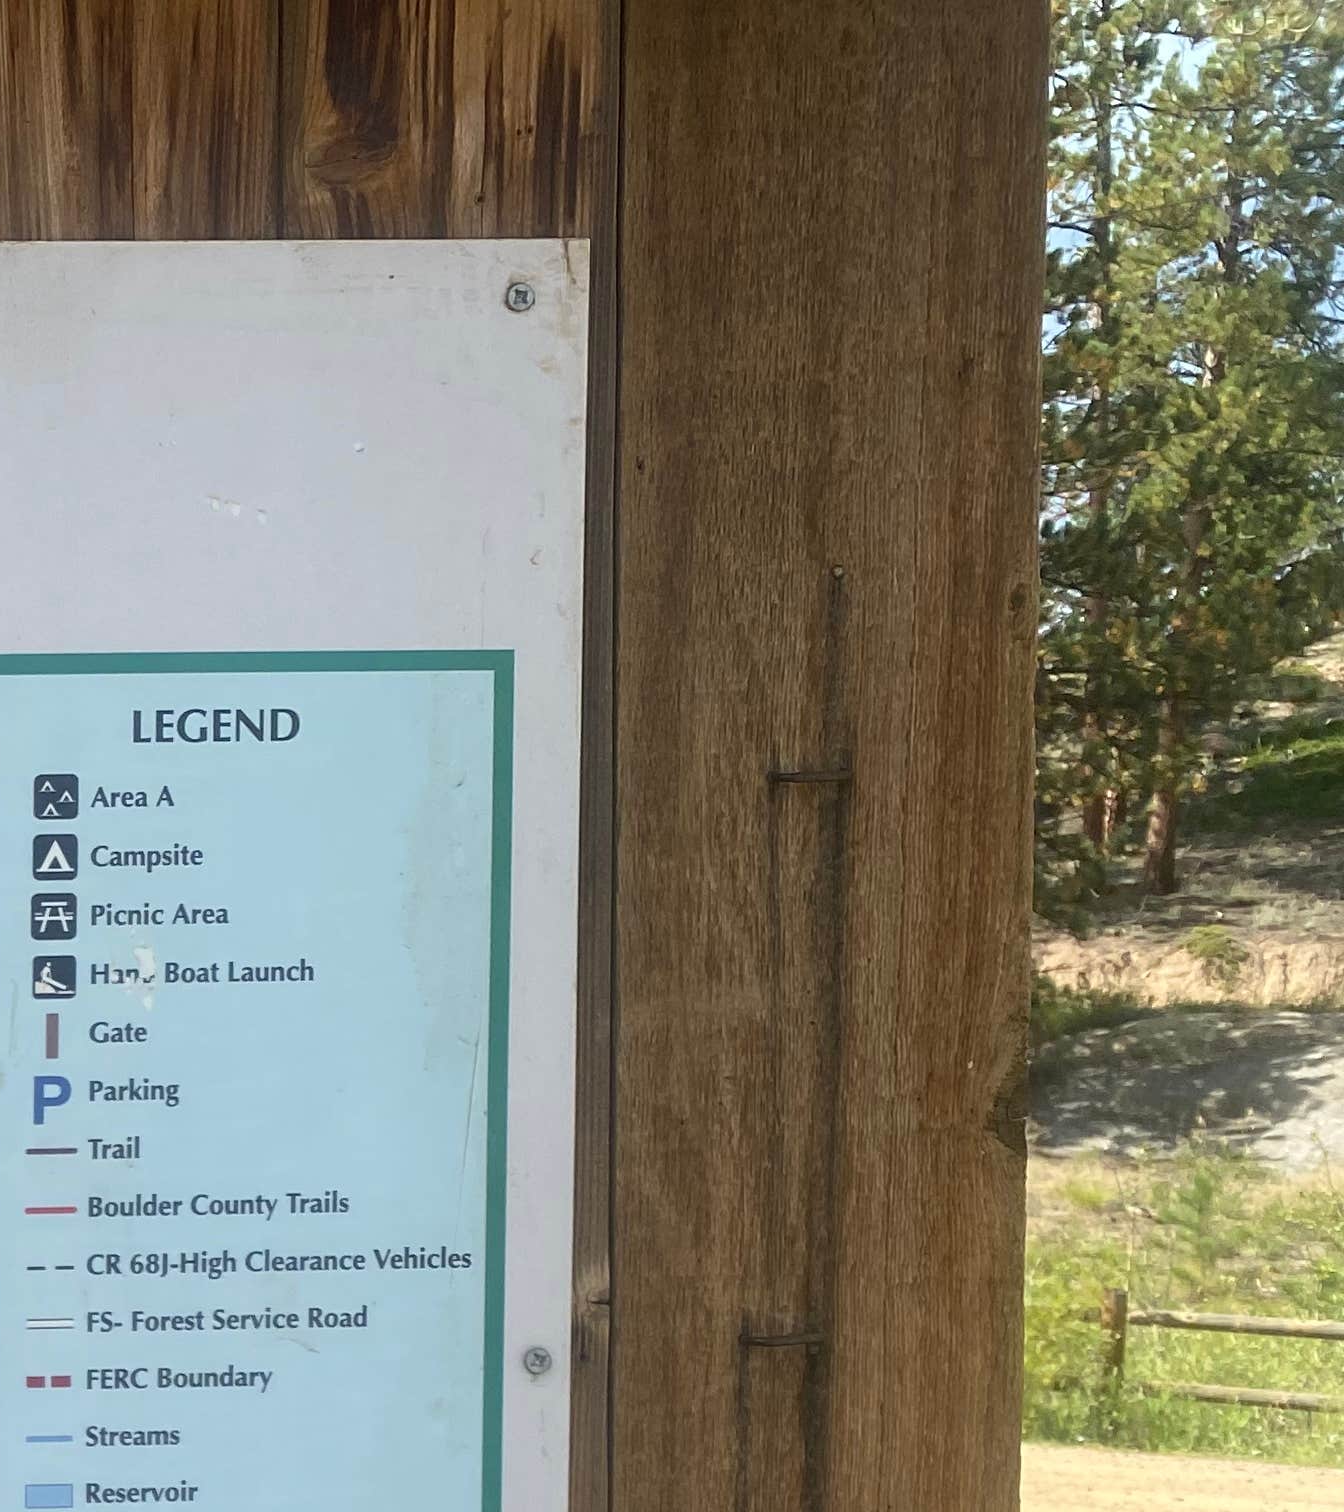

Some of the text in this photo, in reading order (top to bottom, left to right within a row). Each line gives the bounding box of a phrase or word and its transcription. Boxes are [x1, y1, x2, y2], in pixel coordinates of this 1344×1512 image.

[133, 709, 300, 743] LEGEND
[91, 786, 174, 807] Area A
[91, 843, 203, 873] Campsite
[91, 903, 228, 925] Picnic Area
[165, 962, 219, 983] Boat
[229, 959, 314, 982] Launch
[89, 1022, 147, 1043] Gate
[90, 1078, 179, 1107] Parking
[88, 1136, 139, 1159] Trail
[89, 1190, 349, 1220] Boulder County Trails
[87, 1246, 471, 1279] CR 68J-High Clearance Vehicles
[87, 1305, 367, 1332] FS- Forest Service Road
[87, 1365, 272, 1392] FERC Boundary
[86, 1426, 180, 1447] Streams
[86, 1480, 198, 1503] Reservoir
